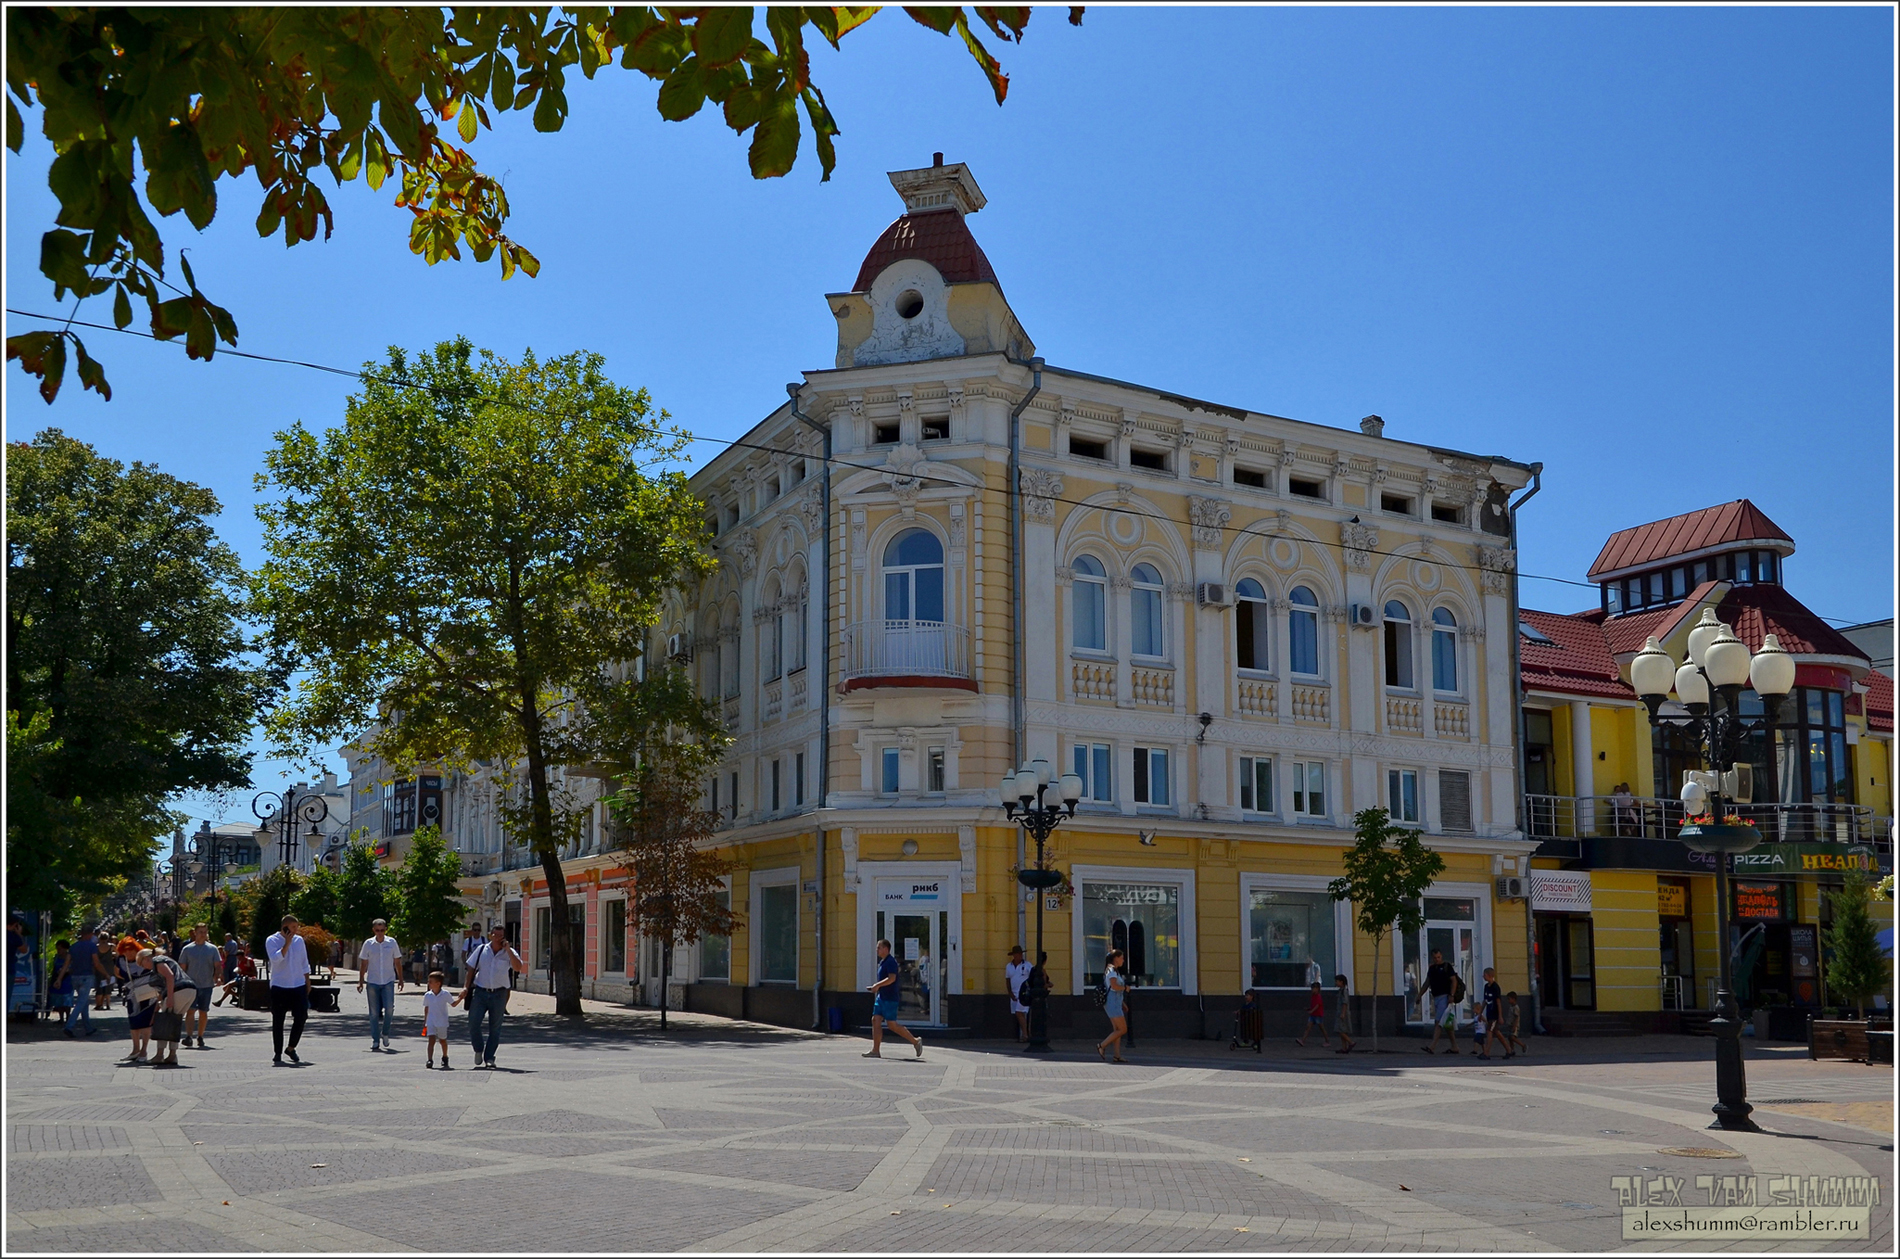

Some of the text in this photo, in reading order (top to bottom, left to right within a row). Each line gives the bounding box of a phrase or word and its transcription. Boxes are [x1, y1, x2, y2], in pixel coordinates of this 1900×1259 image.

[1734, 854, 1785, 864] PIZZA
[912, 883, 939, 894] рнкб
[1543, 883, 1577, 893] DISCOUNT
[1047, 899, 1057, 909] 12
